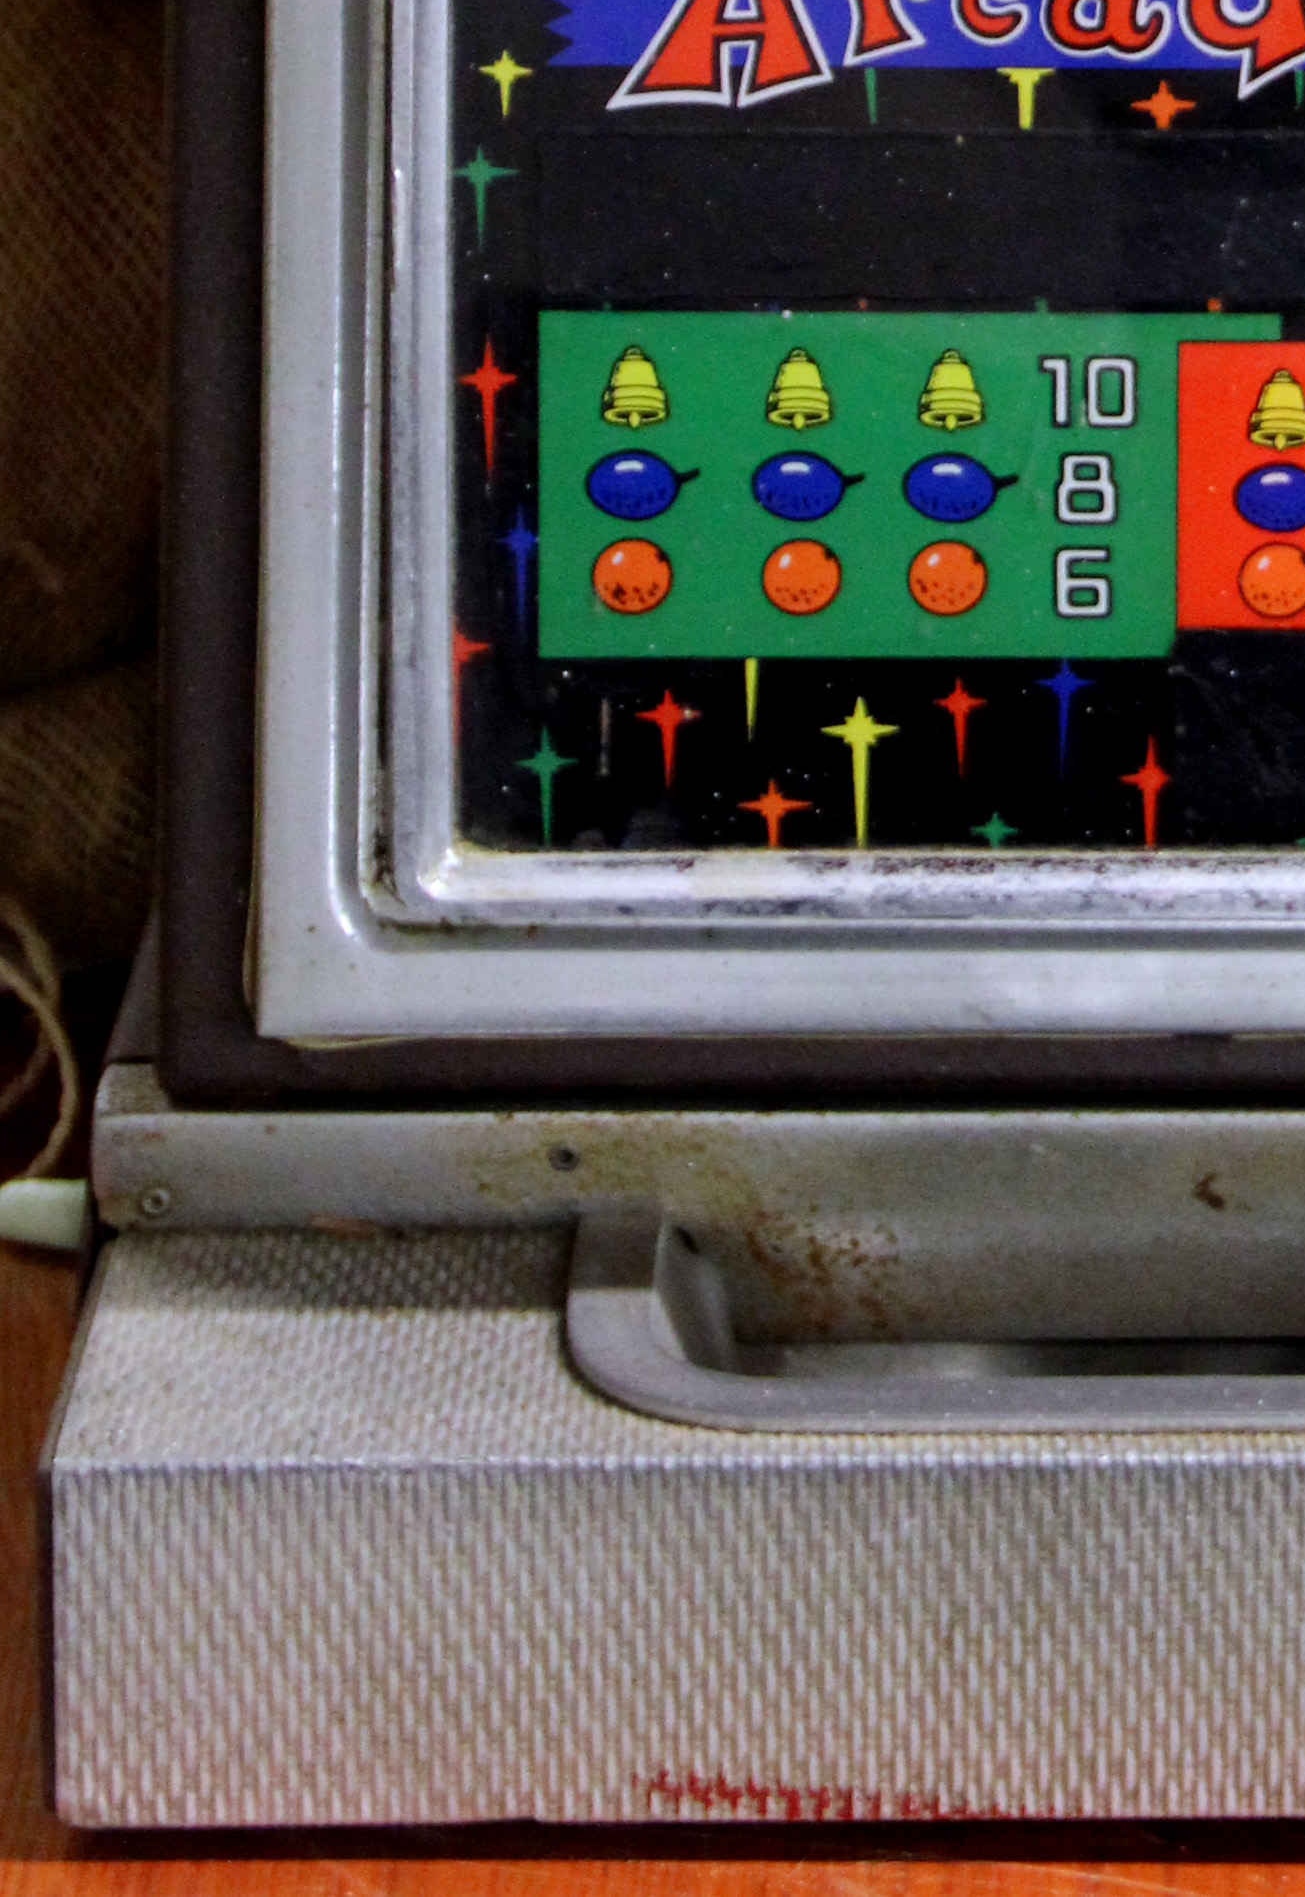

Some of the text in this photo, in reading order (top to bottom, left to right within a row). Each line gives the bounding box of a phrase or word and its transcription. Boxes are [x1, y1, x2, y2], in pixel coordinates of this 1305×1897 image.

[1039, 355, 1137, 428] 10
[1056, 452, 1118, 524] 8
[1054, 546, 1112, 618] 6
